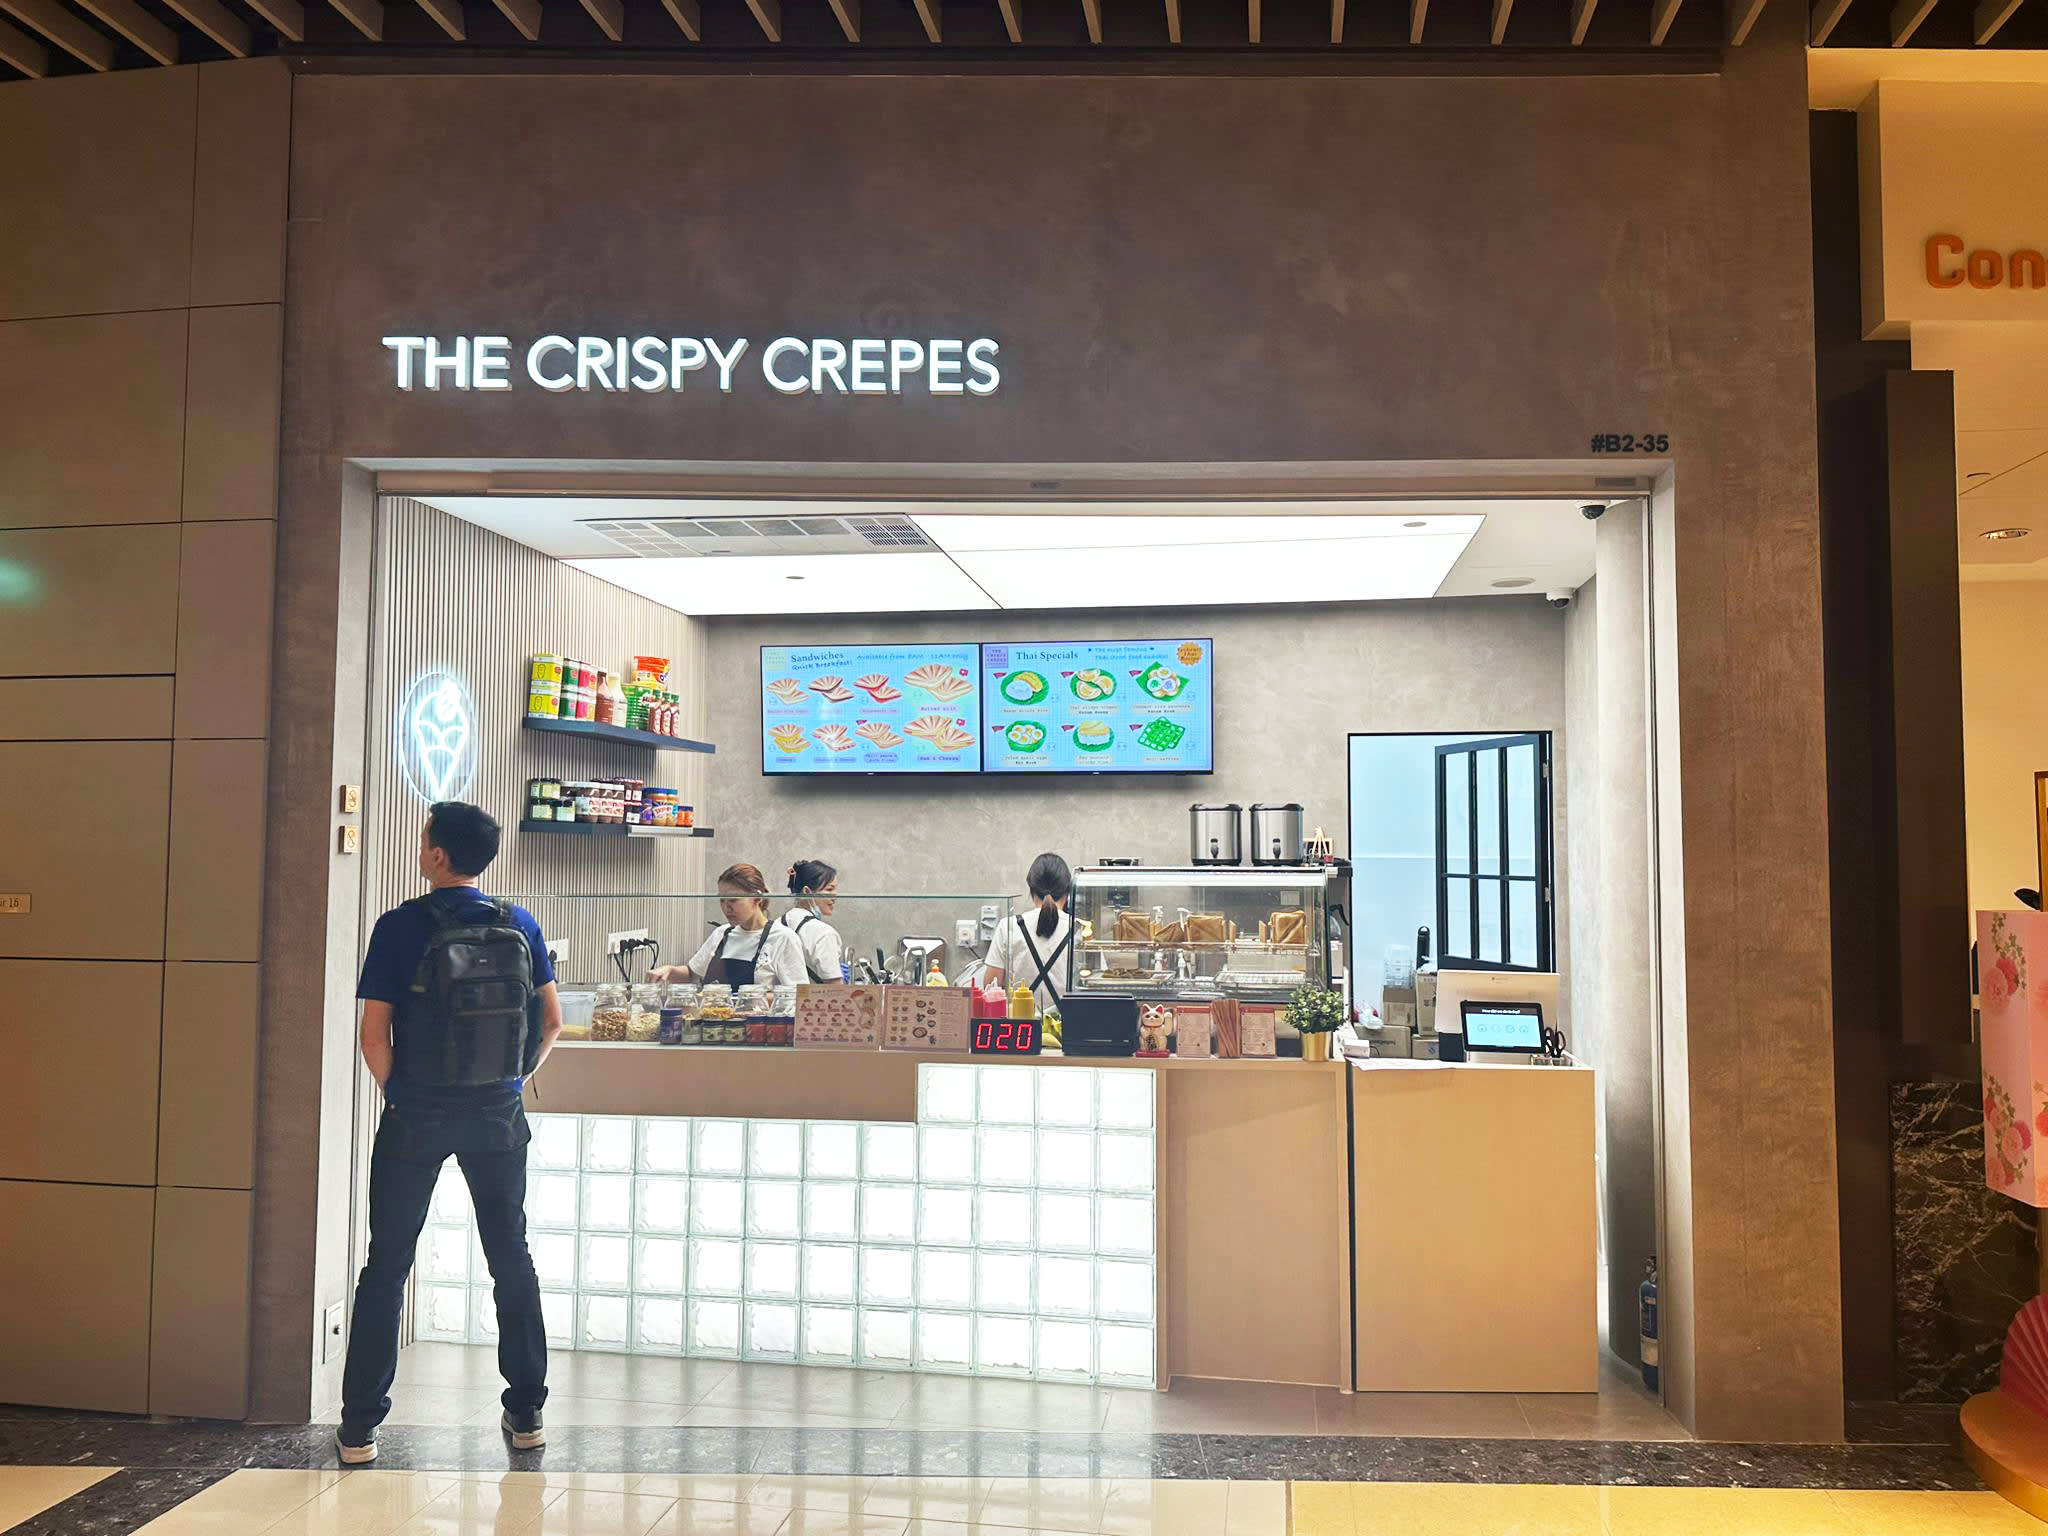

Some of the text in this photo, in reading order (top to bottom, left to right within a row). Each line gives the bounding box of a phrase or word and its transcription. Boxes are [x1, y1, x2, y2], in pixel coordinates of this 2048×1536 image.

[1925, 234, 2048, 289] Con
[382, 335, 1002, 395] THE CRISPY CREPES
[1591, 434, 1669, 453] #B2-35
[791, 651, 845, 663] Sandwiches
[1016, 651, 1037, 660] Thai
[1040, 650, 1079, 661] Specials
[975, 1023, 1033, 1050] 020
